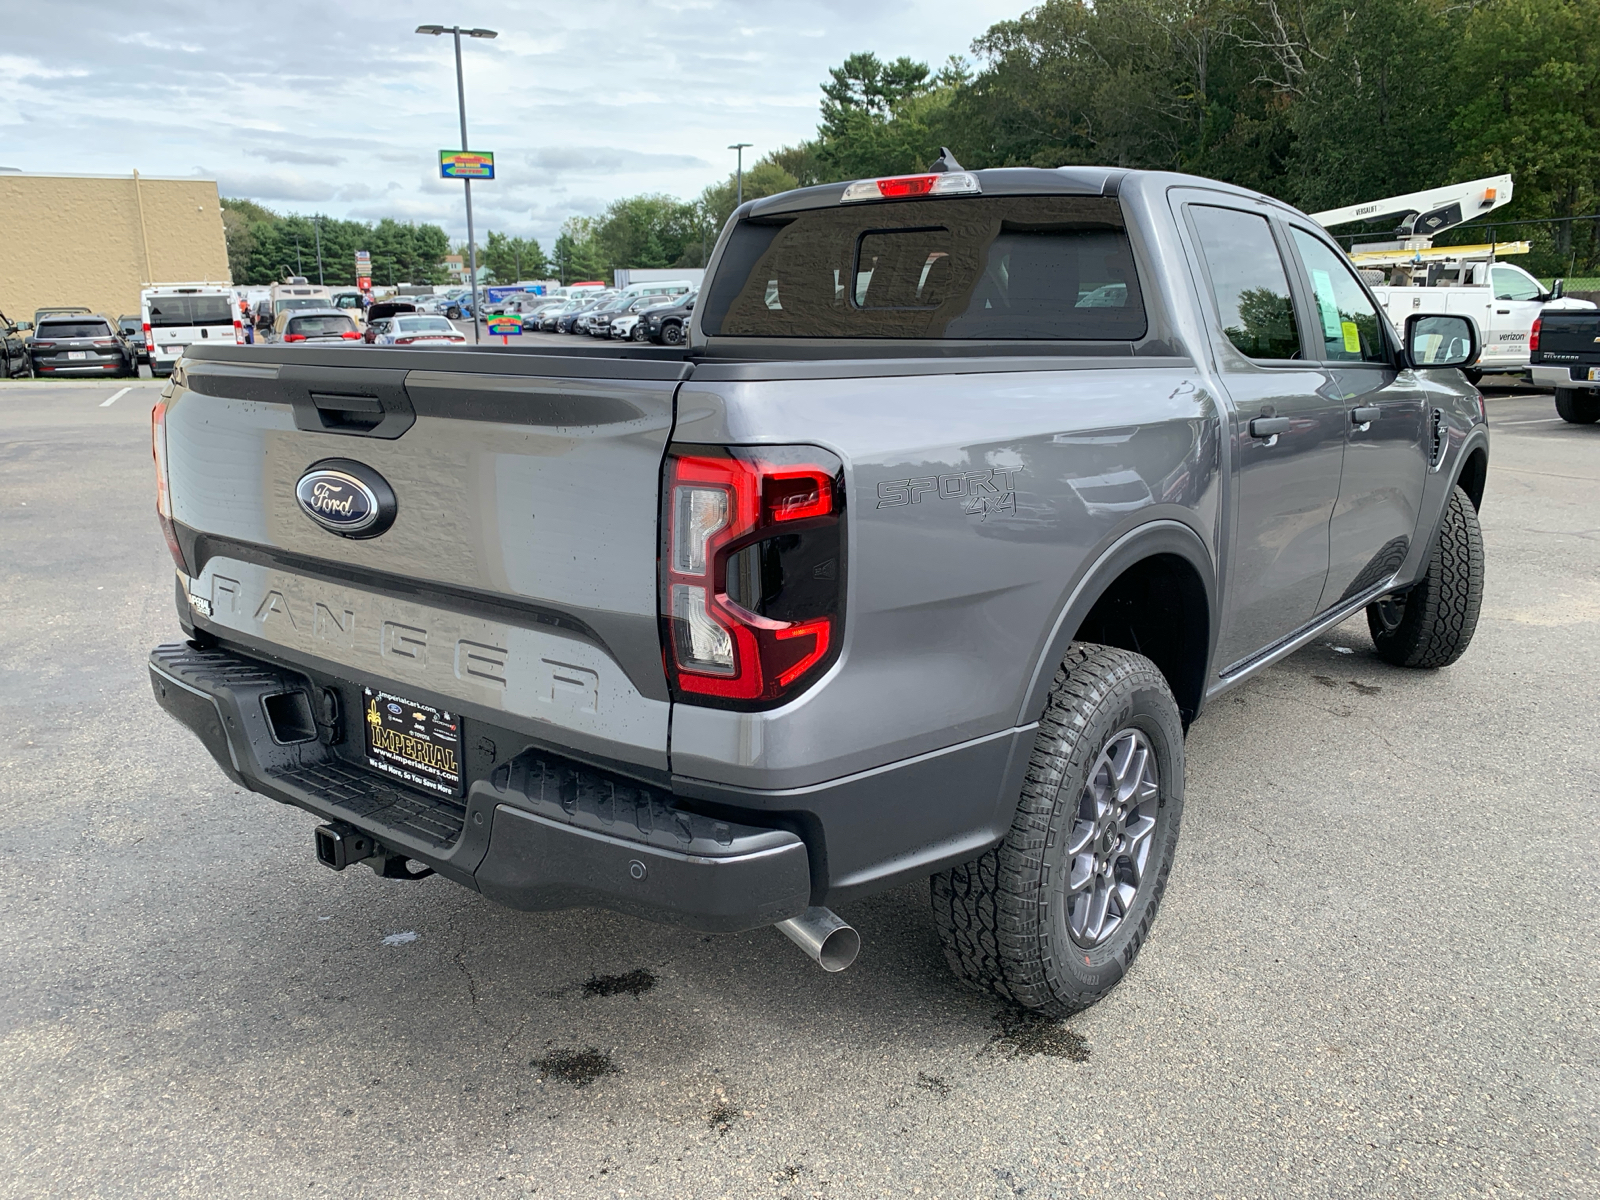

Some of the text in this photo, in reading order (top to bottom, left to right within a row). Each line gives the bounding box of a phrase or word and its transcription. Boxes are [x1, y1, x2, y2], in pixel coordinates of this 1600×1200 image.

[1355, 205, 1377, 216] VERSALIFT
[1499, 332, 1525, 341] verizon
[310, 481, 354, 518] Ford
[876, 465, 1025, 509] SPORT
[211, 573, 600, 714] RANGER
[371, 725, 458, 775] IMPERIAL
[414, 731, 430, 741] TOYOTA
[378, 761, 388, 771] Sell
[388, 766, 403, 778] More,
[403, 771, 411, 780] So
[411, 774, 423, 784] You
[422, 778, 437, 790] Save
[437, 783, 452, 795] More
[1123, 812, 1180, 965] WRANGLER
